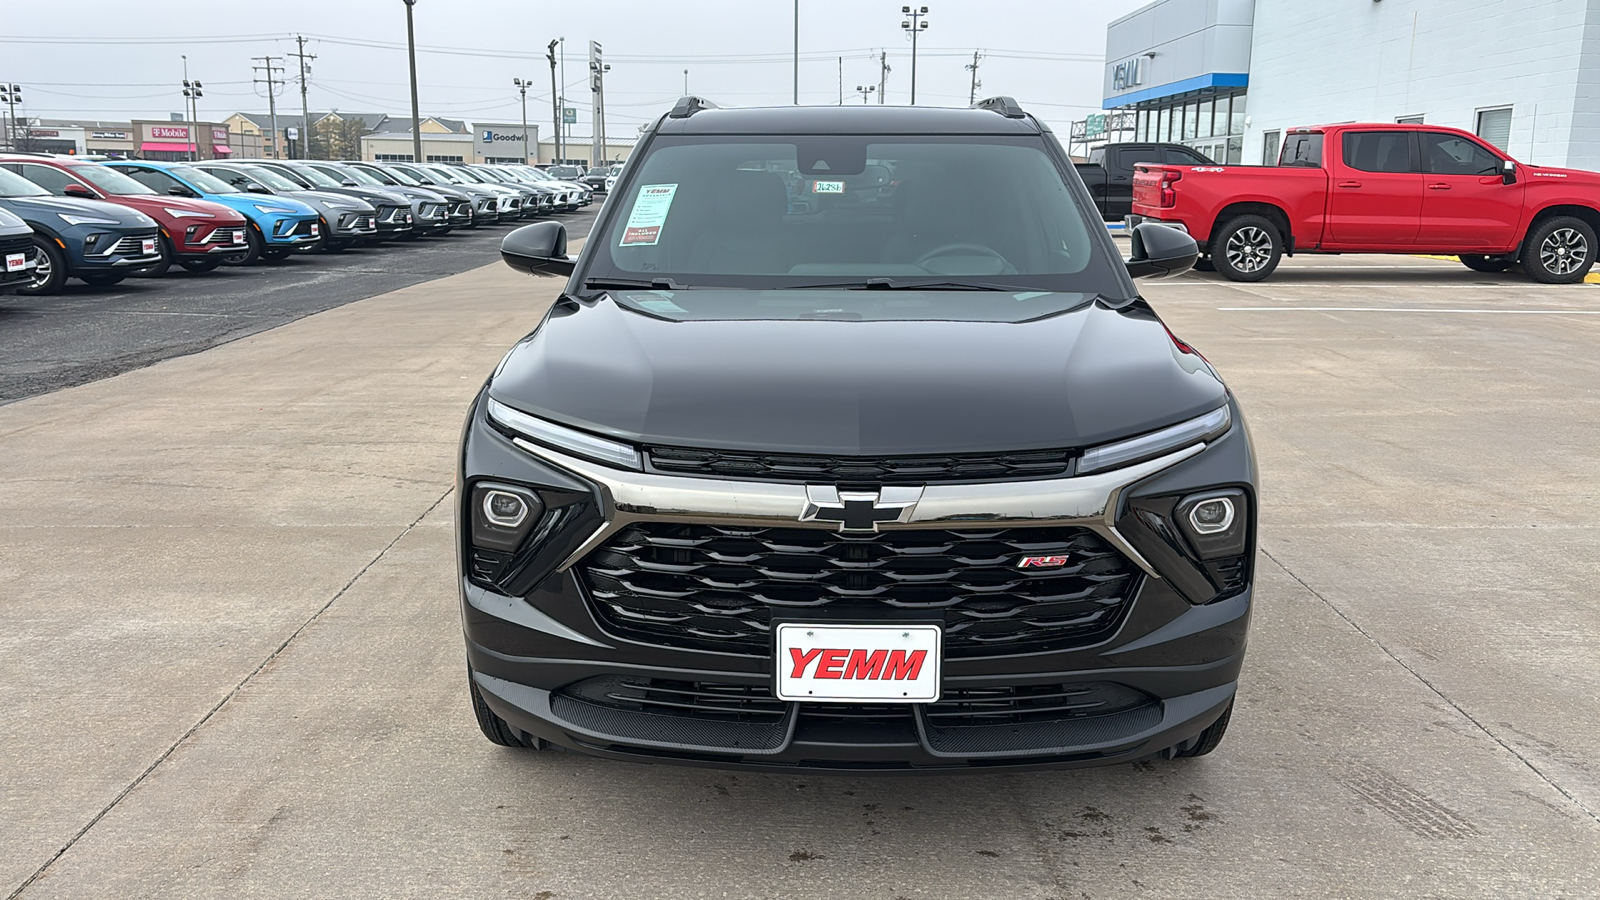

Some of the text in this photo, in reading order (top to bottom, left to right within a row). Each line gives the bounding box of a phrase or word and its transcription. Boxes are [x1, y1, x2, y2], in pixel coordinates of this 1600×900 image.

[161, 128, 186, 137] Mobile
[493, 133, 528, 142] Goodwil
[1017, 555, 1069, 568] RS
[789, 647, 928, 680] YEMM
